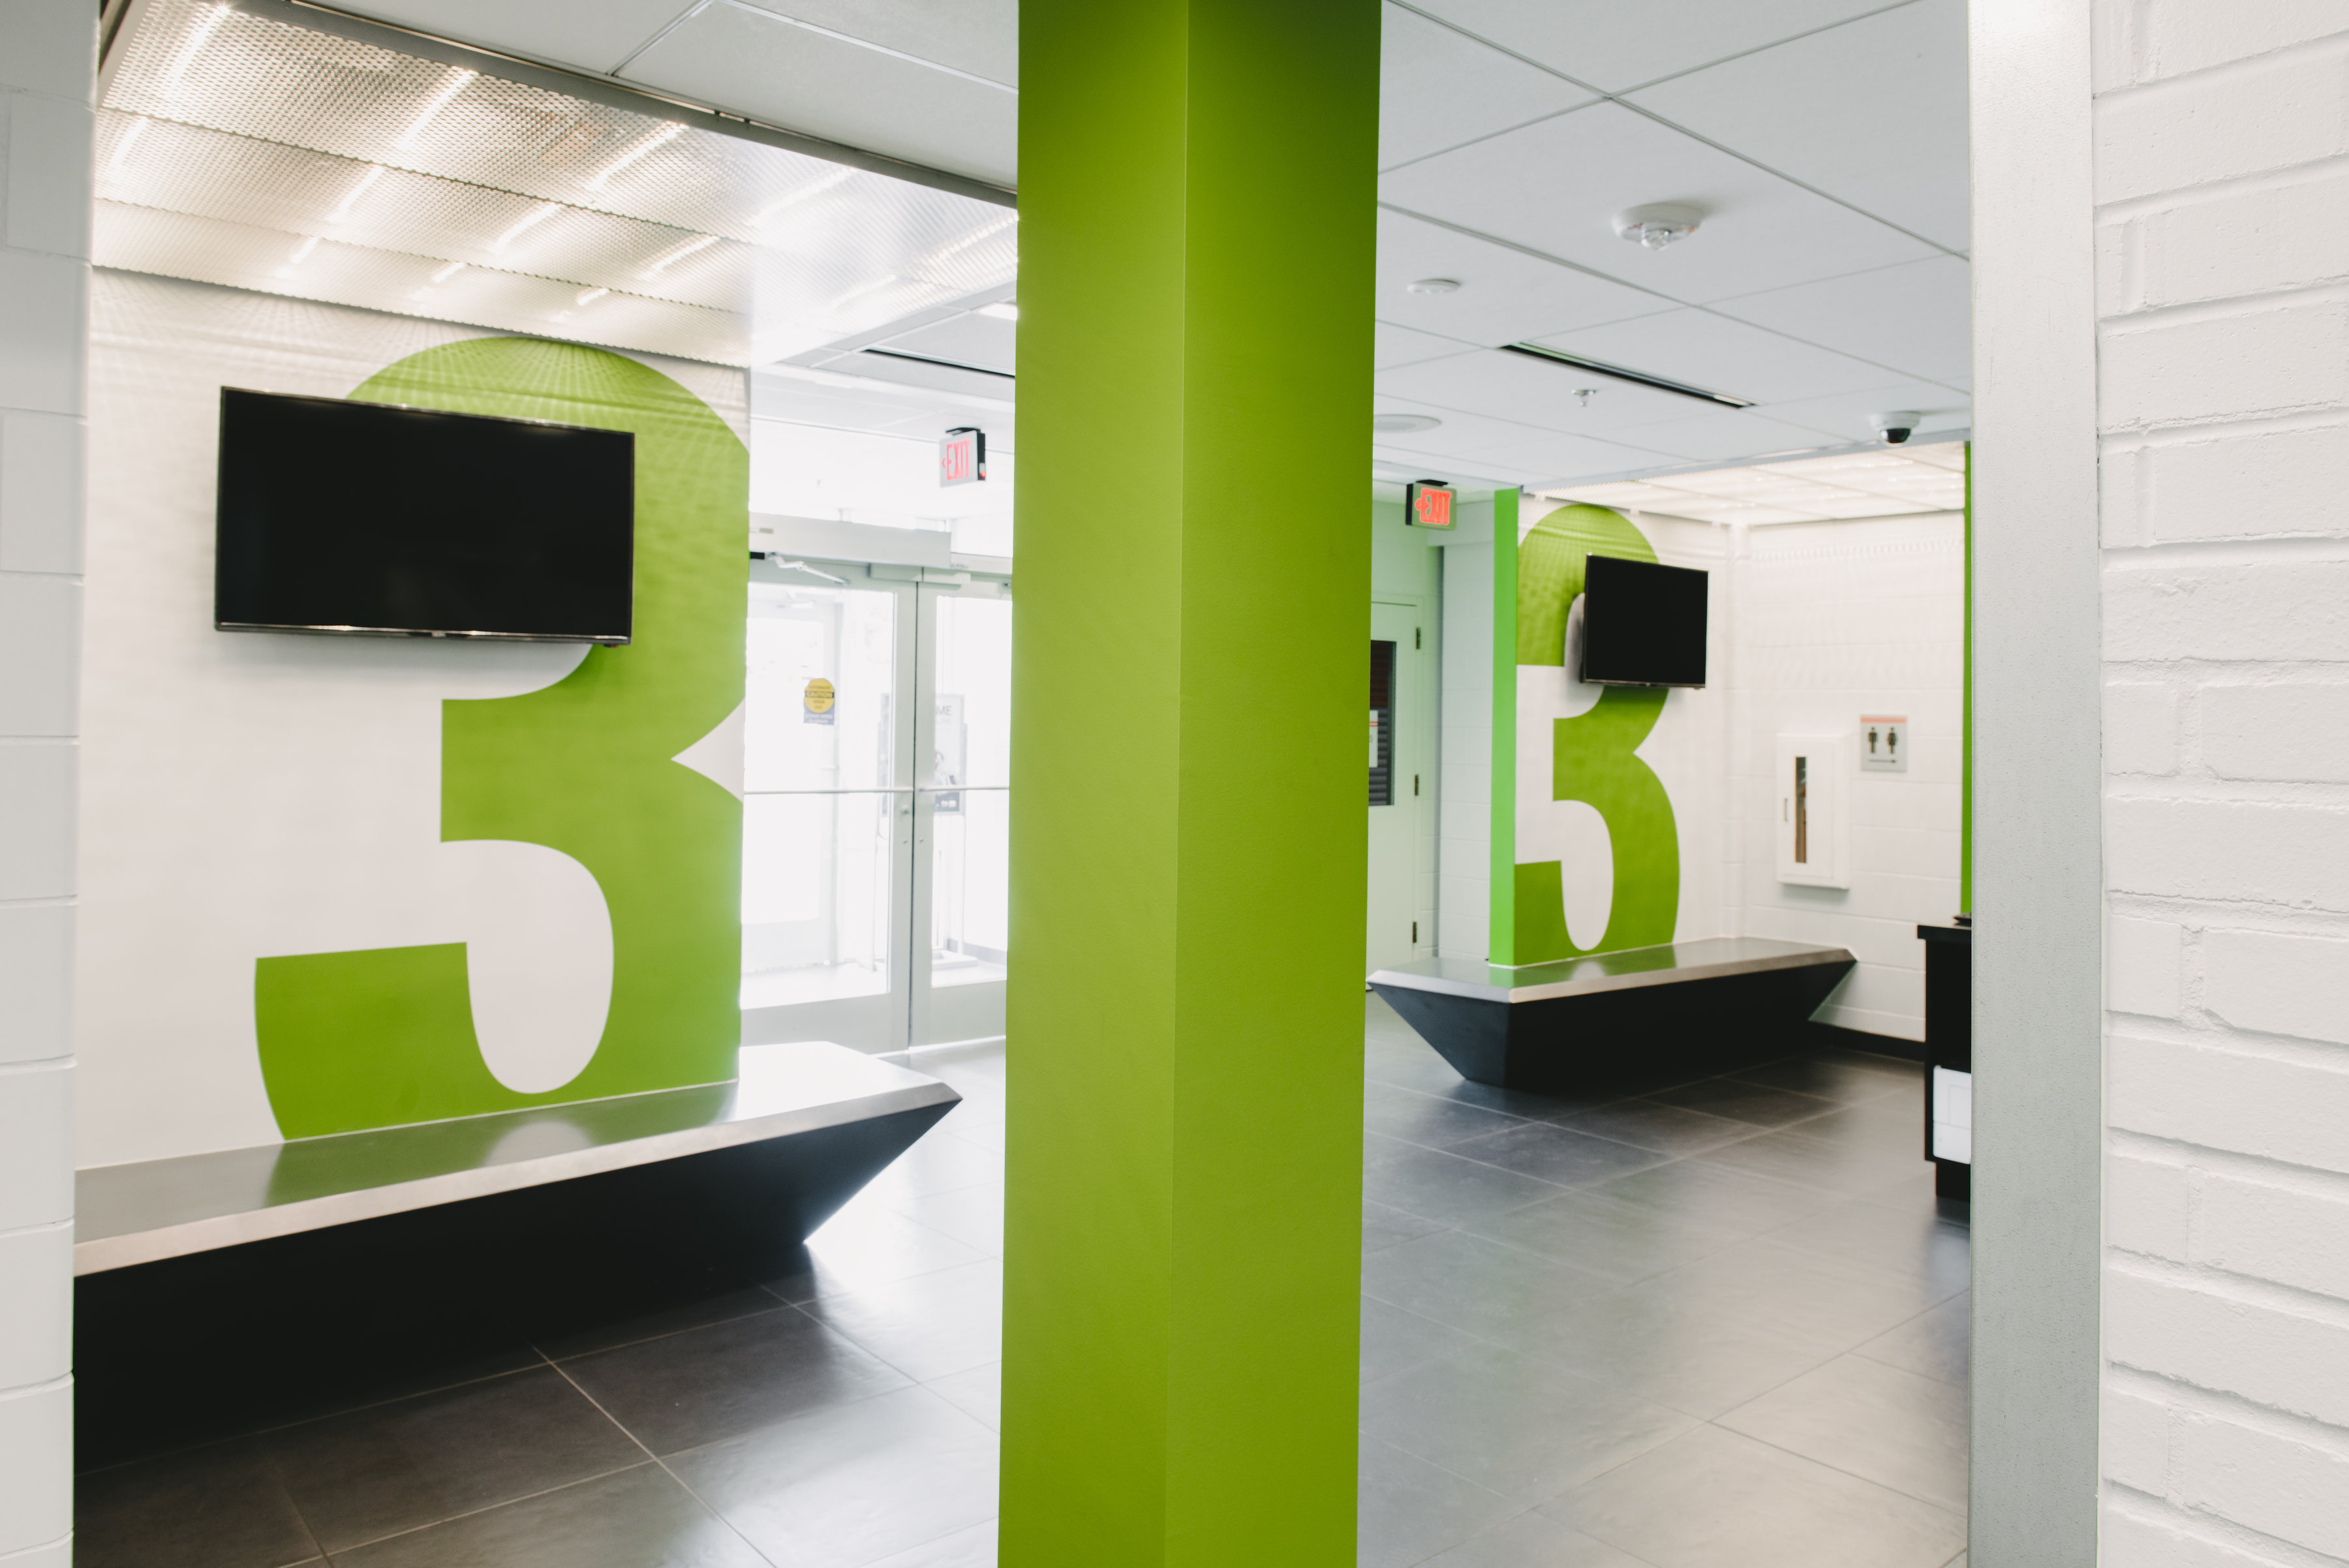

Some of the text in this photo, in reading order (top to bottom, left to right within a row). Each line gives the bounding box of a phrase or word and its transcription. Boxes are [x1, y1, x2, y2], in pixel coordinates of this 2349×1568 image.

[946, 438, 971, 480] EXIT
[1420, 488, 1452, 525] EXIT
[254, 335, 750, 1141] 3
